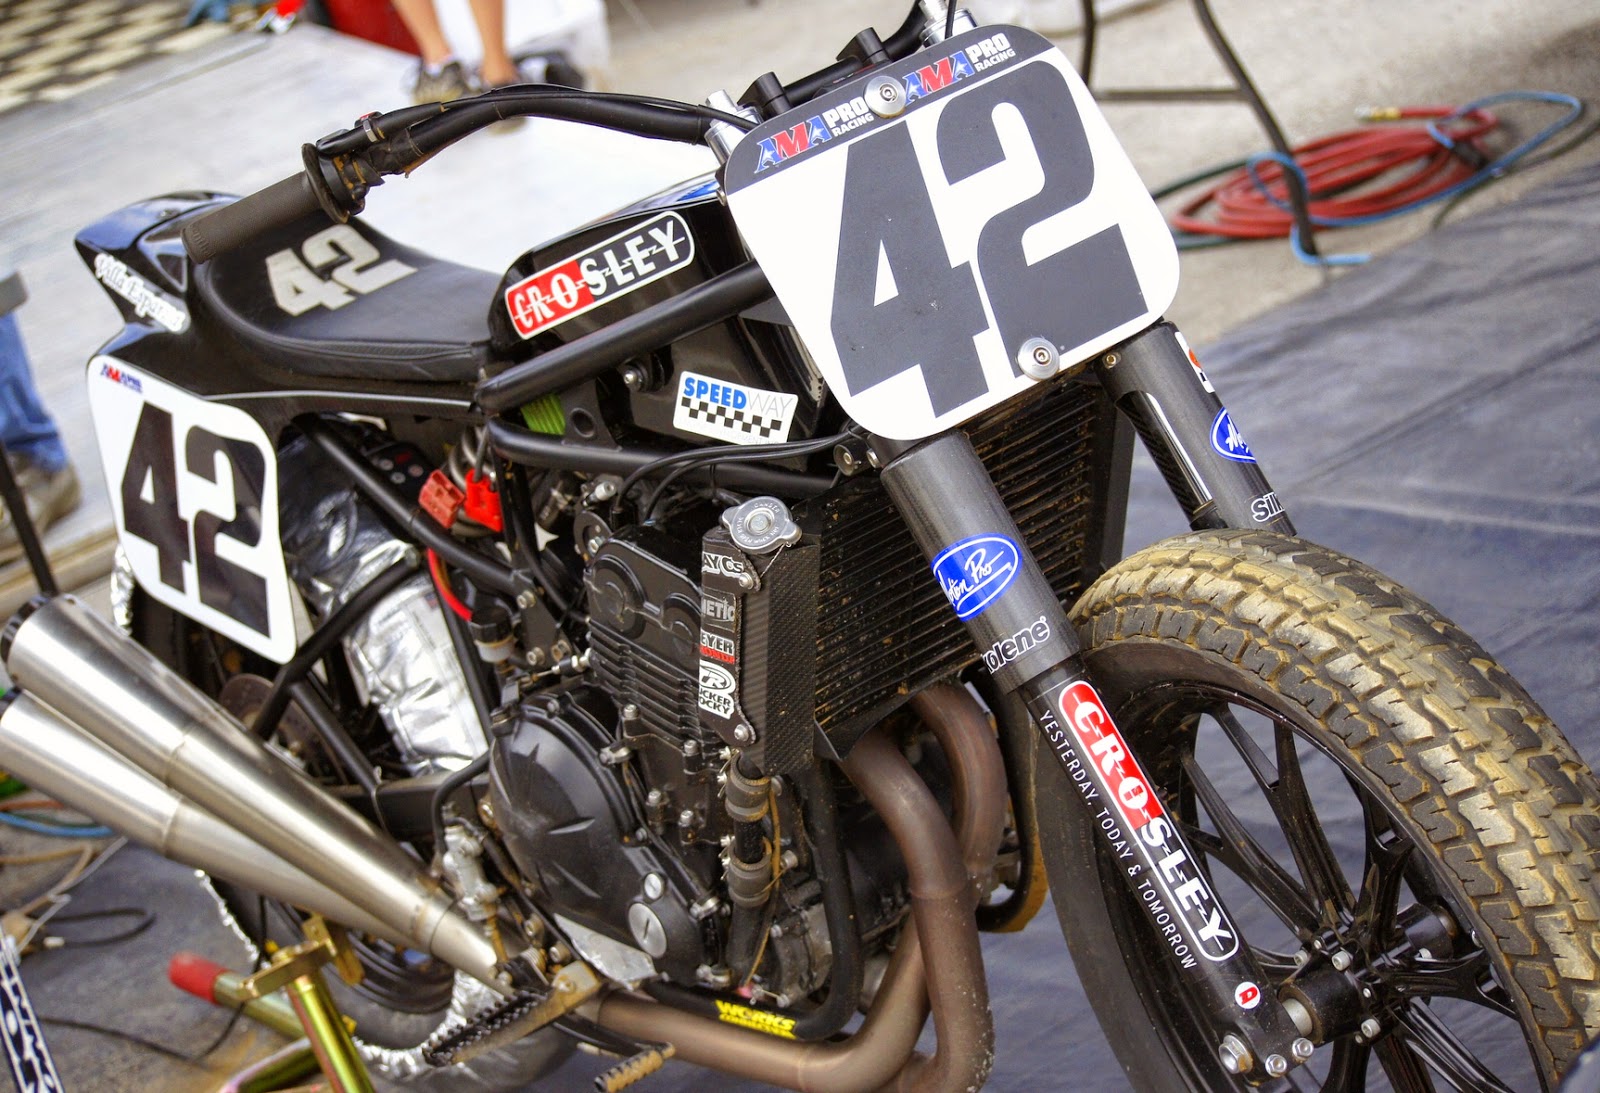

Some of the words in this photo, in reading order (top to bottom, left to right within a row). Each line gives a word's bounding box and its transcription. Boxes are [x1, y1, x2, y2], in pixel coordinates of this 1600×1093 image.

[902, 50, 975, 106] AMA
[965, 32, 1011, 64] PRO
[975, 48, 1016, 73] RACING
[754, 115, 833, 174] AMA
[822, 96, 870, 129] PRO
[831, 113, 875, 138] RACING
[830, 60, 1149, 418] 42
[265, 224, 419, 316] 42
[683, 377, 793, 418] SPEEDWAY
[121, 400, 271, 640] 42
[1251, 491, 1285, 523] Sil
[964, 548, 1004, 584] Pro
[1039, 710, 1100, 806] YESTERDAY,
[1096, 807, 1134, 860] TODAY
[1127, 864, 1142, 877] &
[1137, 879, 1198, 970] TOMORROW
[715, 1000, 796, 1031] WORKS
